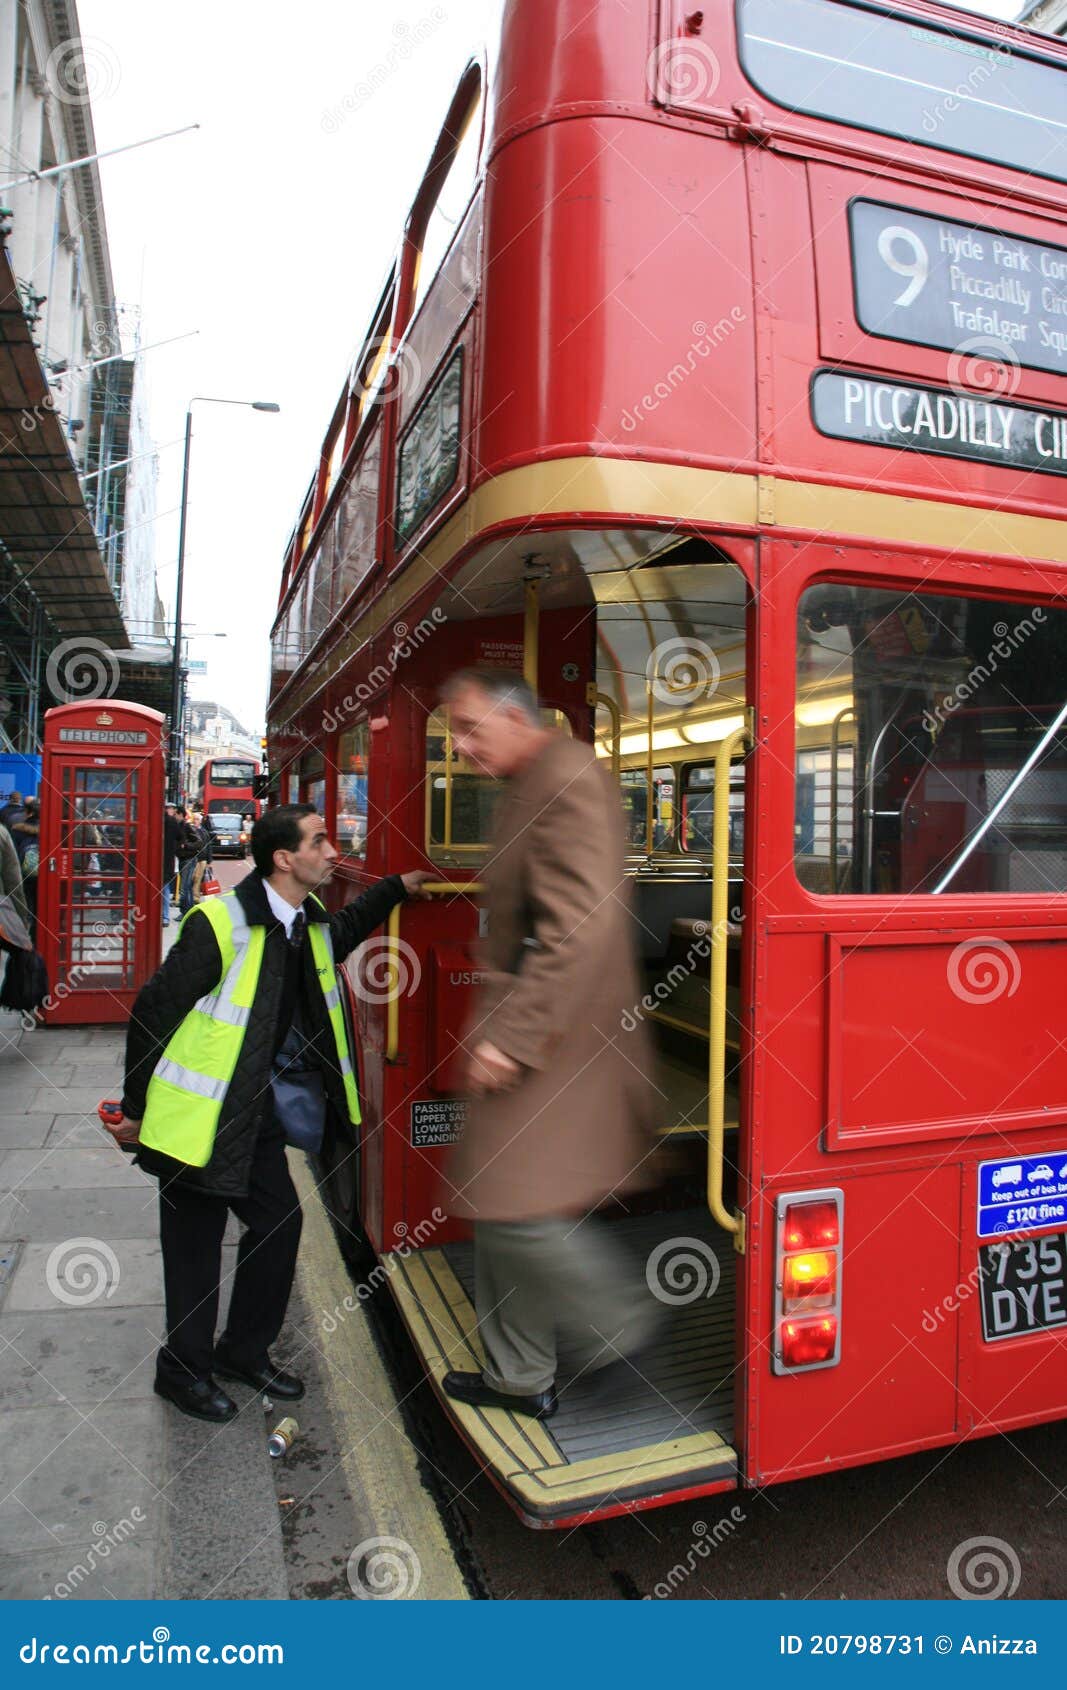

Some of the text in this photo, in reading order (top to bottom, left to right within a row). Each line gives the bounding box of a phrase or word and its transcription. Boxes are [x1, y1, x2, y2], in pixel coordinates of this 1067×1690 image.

[878, 226, 928, 307] 9
[939, 227, 984, 263] Hyde
[993, 239, 1031, 272] Park
[950, 265, 1031, 314] Piccadilly
[949, 301, 1028, 344] Trafalgar
[844, 379, 1016, 449] PICCADILLY
[64, 729, 144, 744] TELEPHONE
[415, 1113, 446, 1124] UPPER
[415, 1123, 451, 1134] LOWER
[991, 1192, 1013, 1202] Keep
[1014, 1188, 1029, 1198] out
[1030, 1185, 1040, 1196] of
[1041, 1184, 1057, 1194] bus
[1006, 1204, 1065, 1224] £120 fine
[988, 1233, 1062, 1284] 735
[992, 1279, 1066, 1332] DYE
